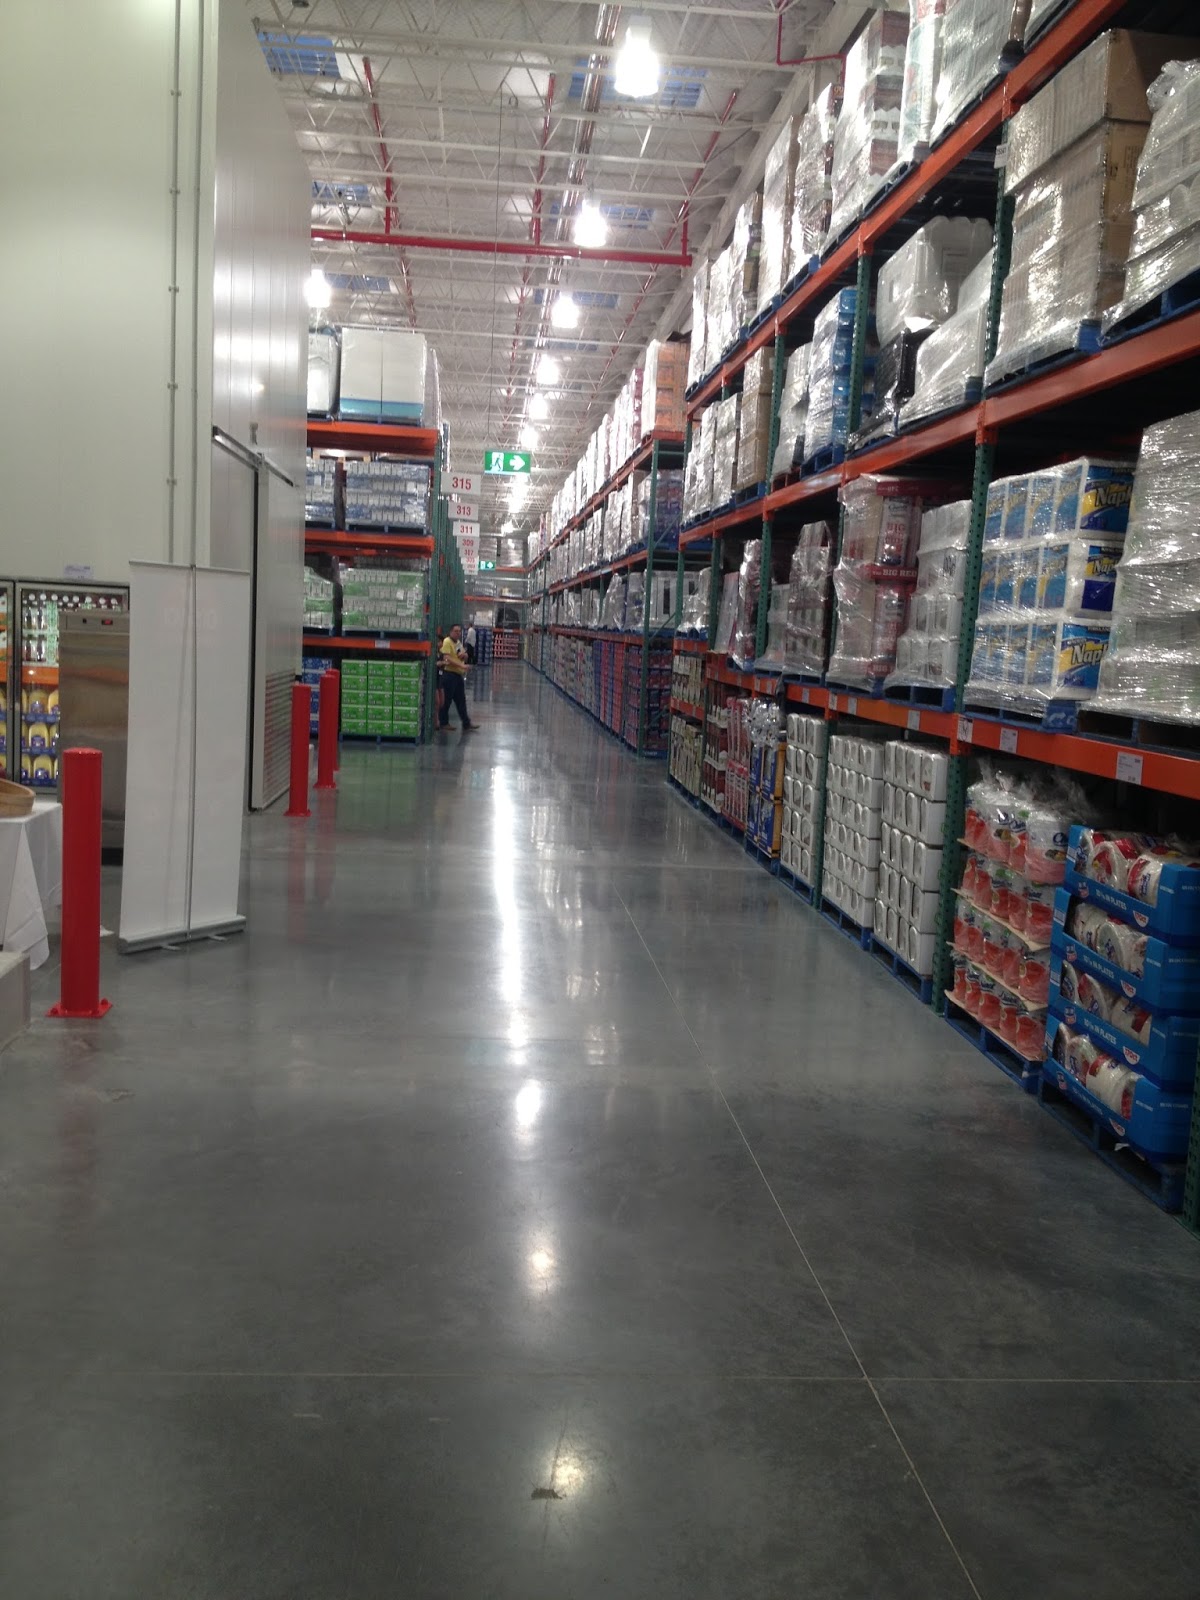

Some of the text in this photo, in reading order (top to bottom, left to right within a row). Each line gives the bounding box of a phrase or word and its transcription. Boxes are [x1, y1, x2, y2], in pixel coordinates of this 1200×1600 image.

[452, 476, 472, 491] 315
[456, 505, 471, 517] 313
[460, 525, 473, 534] 311
[882, 568, 899, 577] BIG
[899, 569, 918, 577] RED
[1110, 896, 1127, 911] PLATES
[1097, 963, 1115, 979] PLATES
[1099, 1028, 1117, 1045] PLATES
